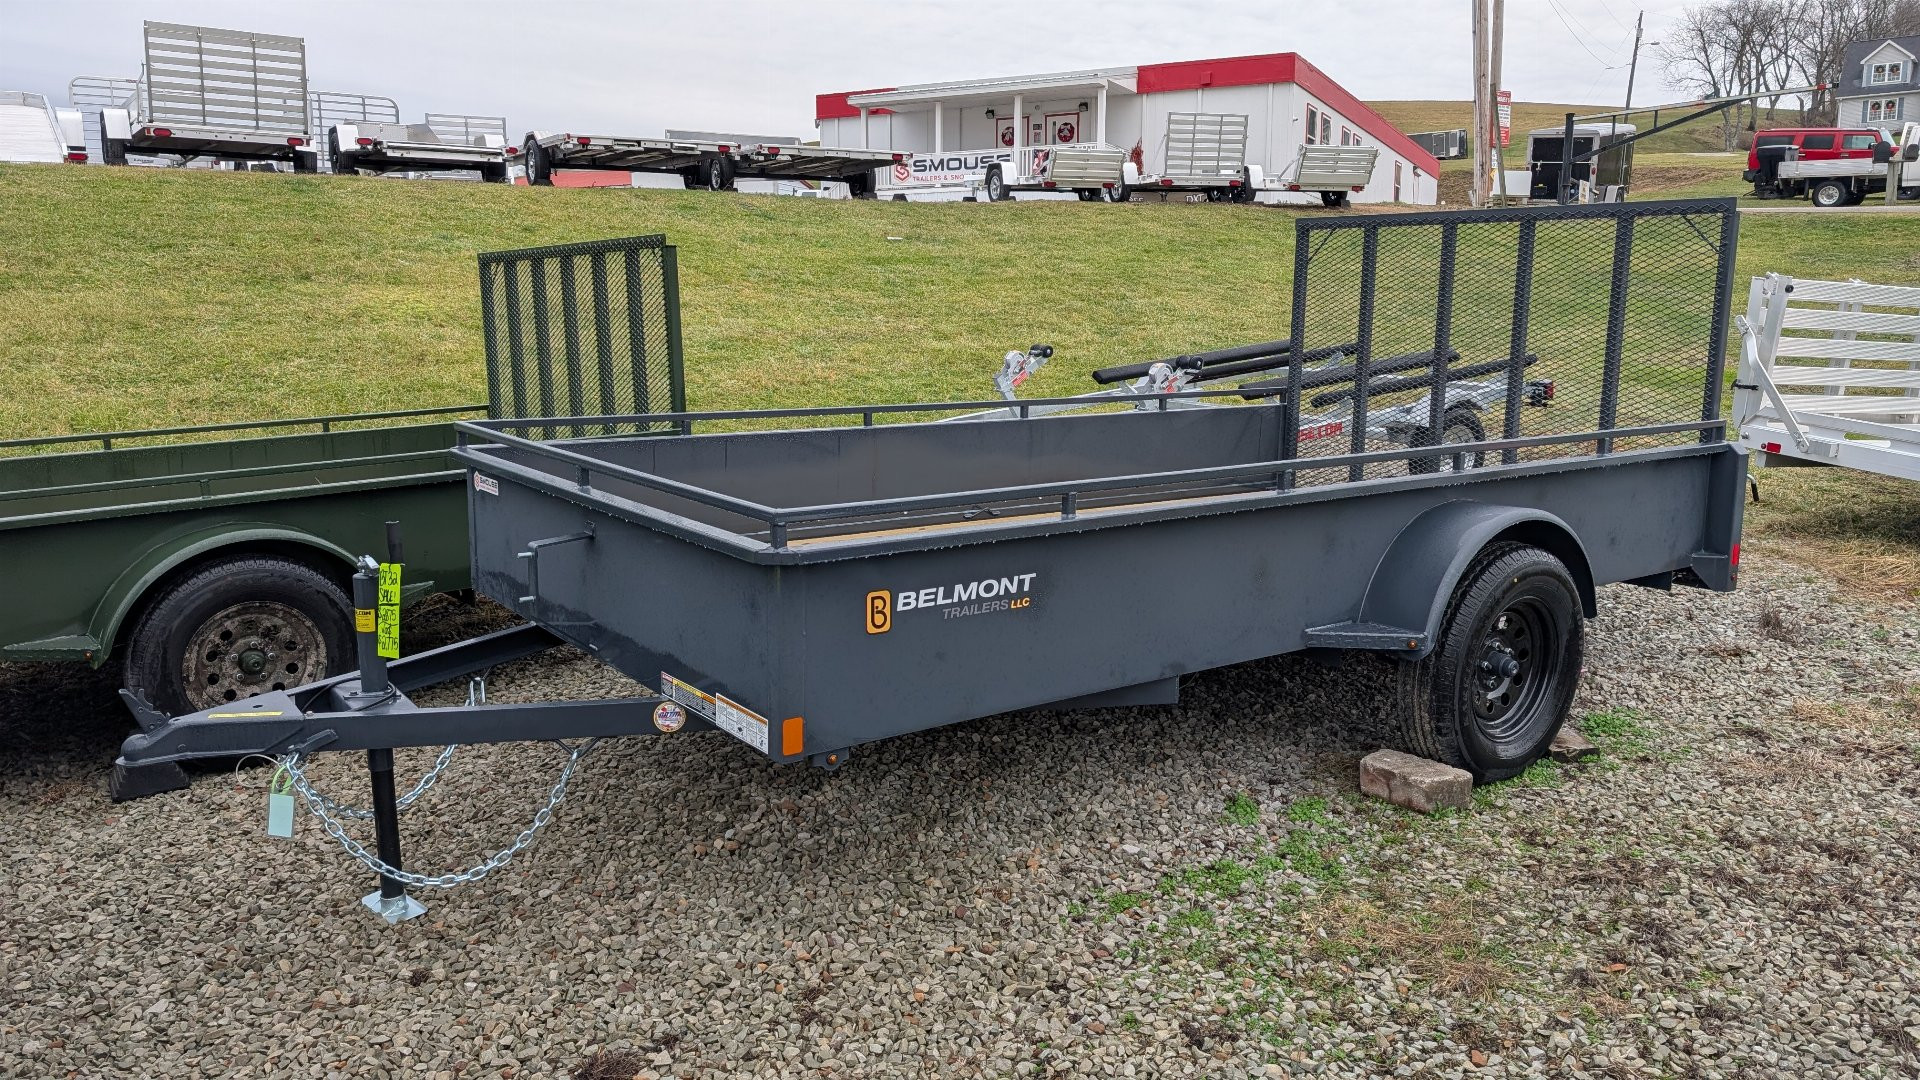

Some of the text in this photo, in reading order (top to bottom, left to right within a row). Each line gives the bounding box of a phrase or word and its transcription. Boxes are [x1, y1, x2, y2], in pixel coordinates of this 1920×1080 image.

[913, 154, 1011, 172] SMOUSE
[896, 573, 1037, 612] BELMONT
[942, 597, 1031, 620] TRAILERS LLC
